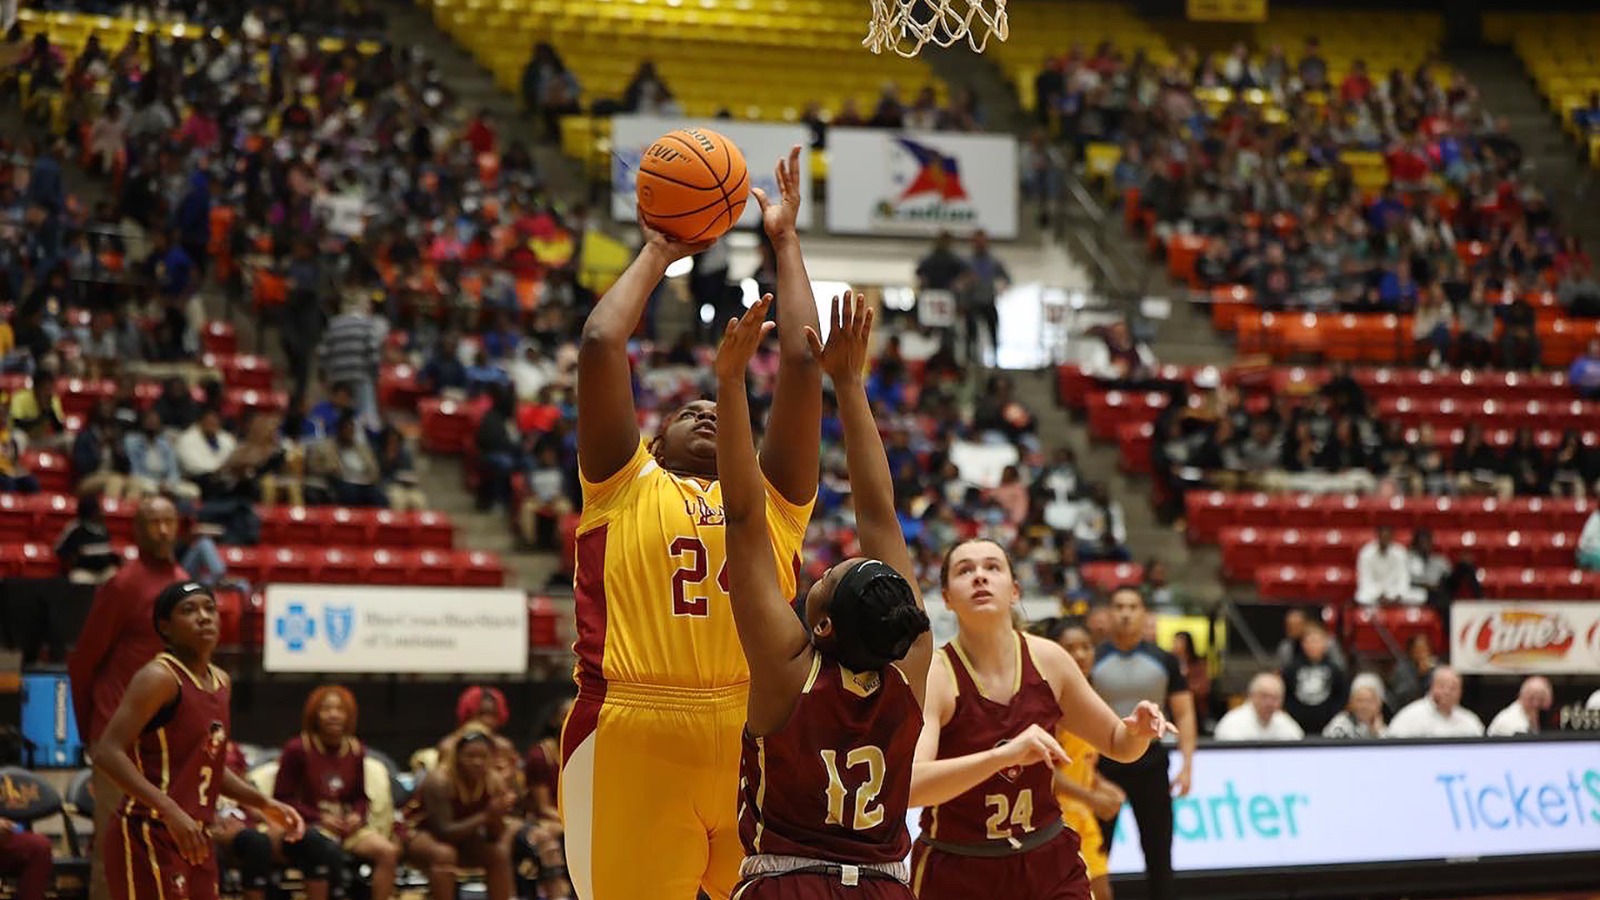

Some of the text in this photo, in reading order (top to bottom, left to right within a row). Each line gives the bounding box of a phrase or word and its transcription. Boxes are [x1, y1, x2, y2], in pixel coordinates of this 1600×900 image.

[669, 536, 729, 617] 2
[198, 766, 213, 807] 2
[820, 745, 886, 831] 12
[985, 788, 1036, 840] 24
[1115, 777, 1300, 843] arter
